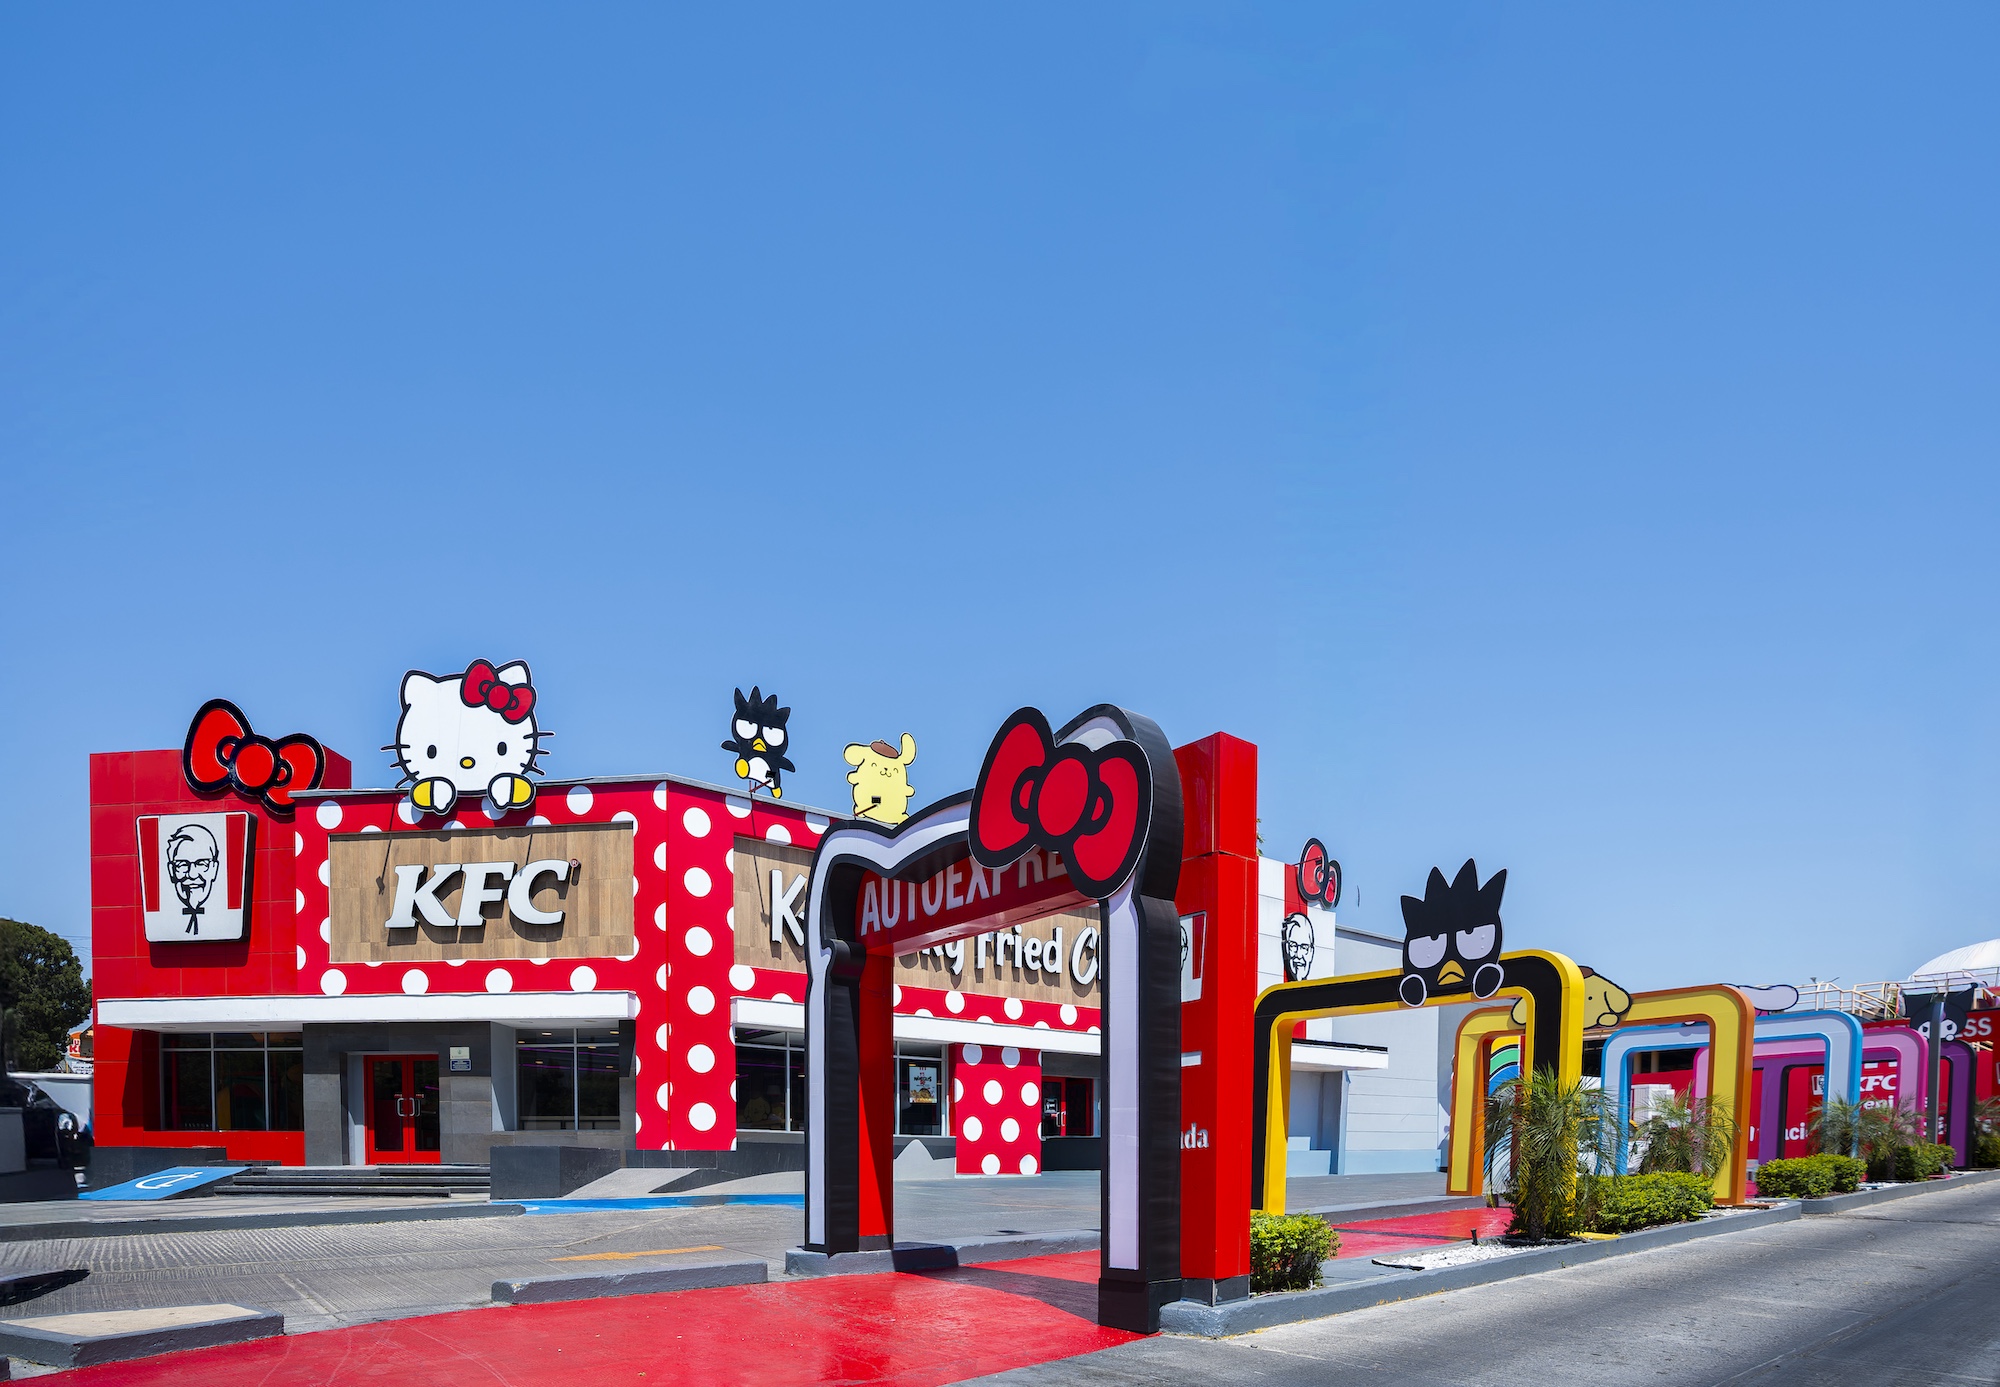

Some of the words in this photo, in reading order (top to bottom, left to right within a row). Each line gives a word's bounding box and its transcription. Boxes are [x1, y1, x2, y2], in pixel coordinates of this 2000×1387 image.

[385, 859, 570, 928] KFC
[769, 868, 806, 947] K
[976, 924, 1063, 973] Fried
[1071, 926, 1102, 985] C
